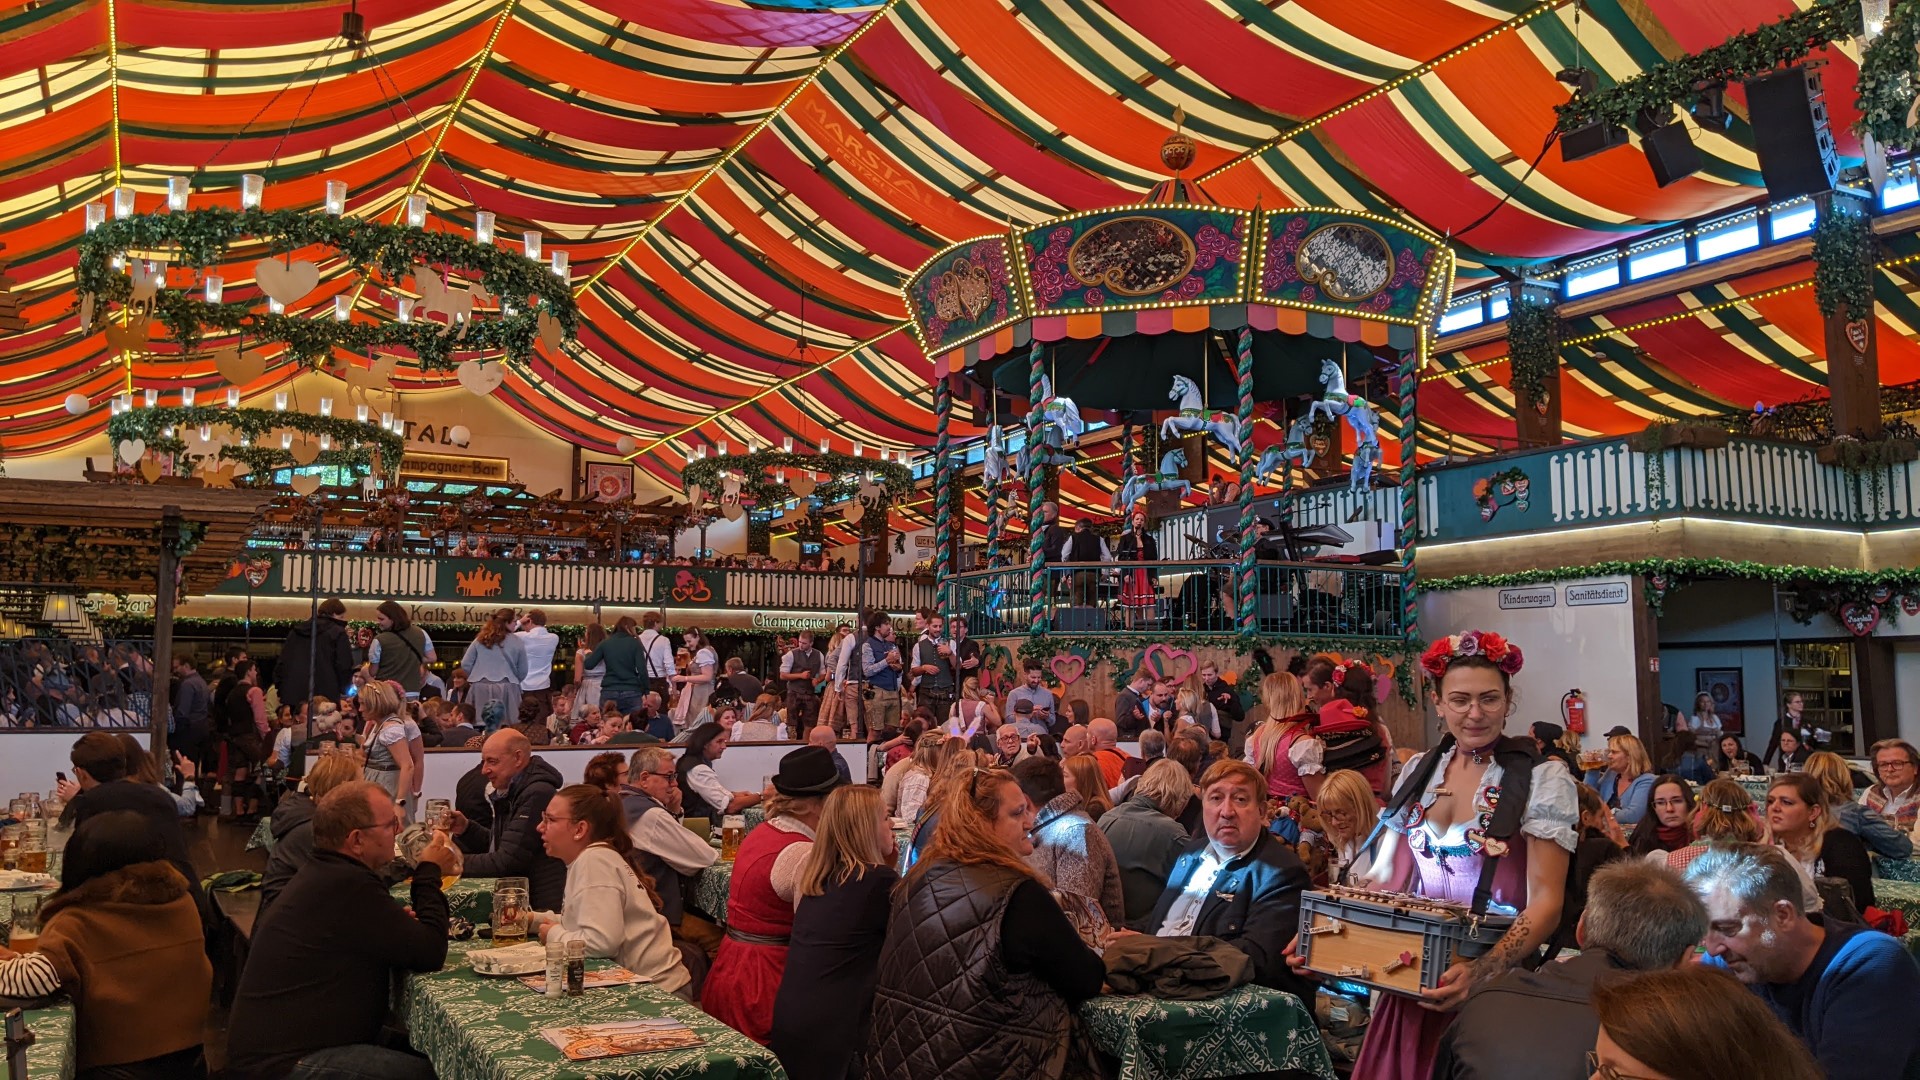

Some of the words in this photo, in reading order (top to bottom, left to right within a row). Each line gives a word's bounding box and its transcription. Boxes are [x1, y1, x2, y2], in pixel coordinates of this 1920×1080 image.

[836, 146, 896, 196] FESTZELT
[401, 460, 498, 475] ampagner-Bar
[965, 554, 970, 567] L
[1503, 594, 1551, 605] Kinderwagen
[1569, 588, 1624, 601] Sanitätsdienst
[411, 604, 456, 622] Kalbs
